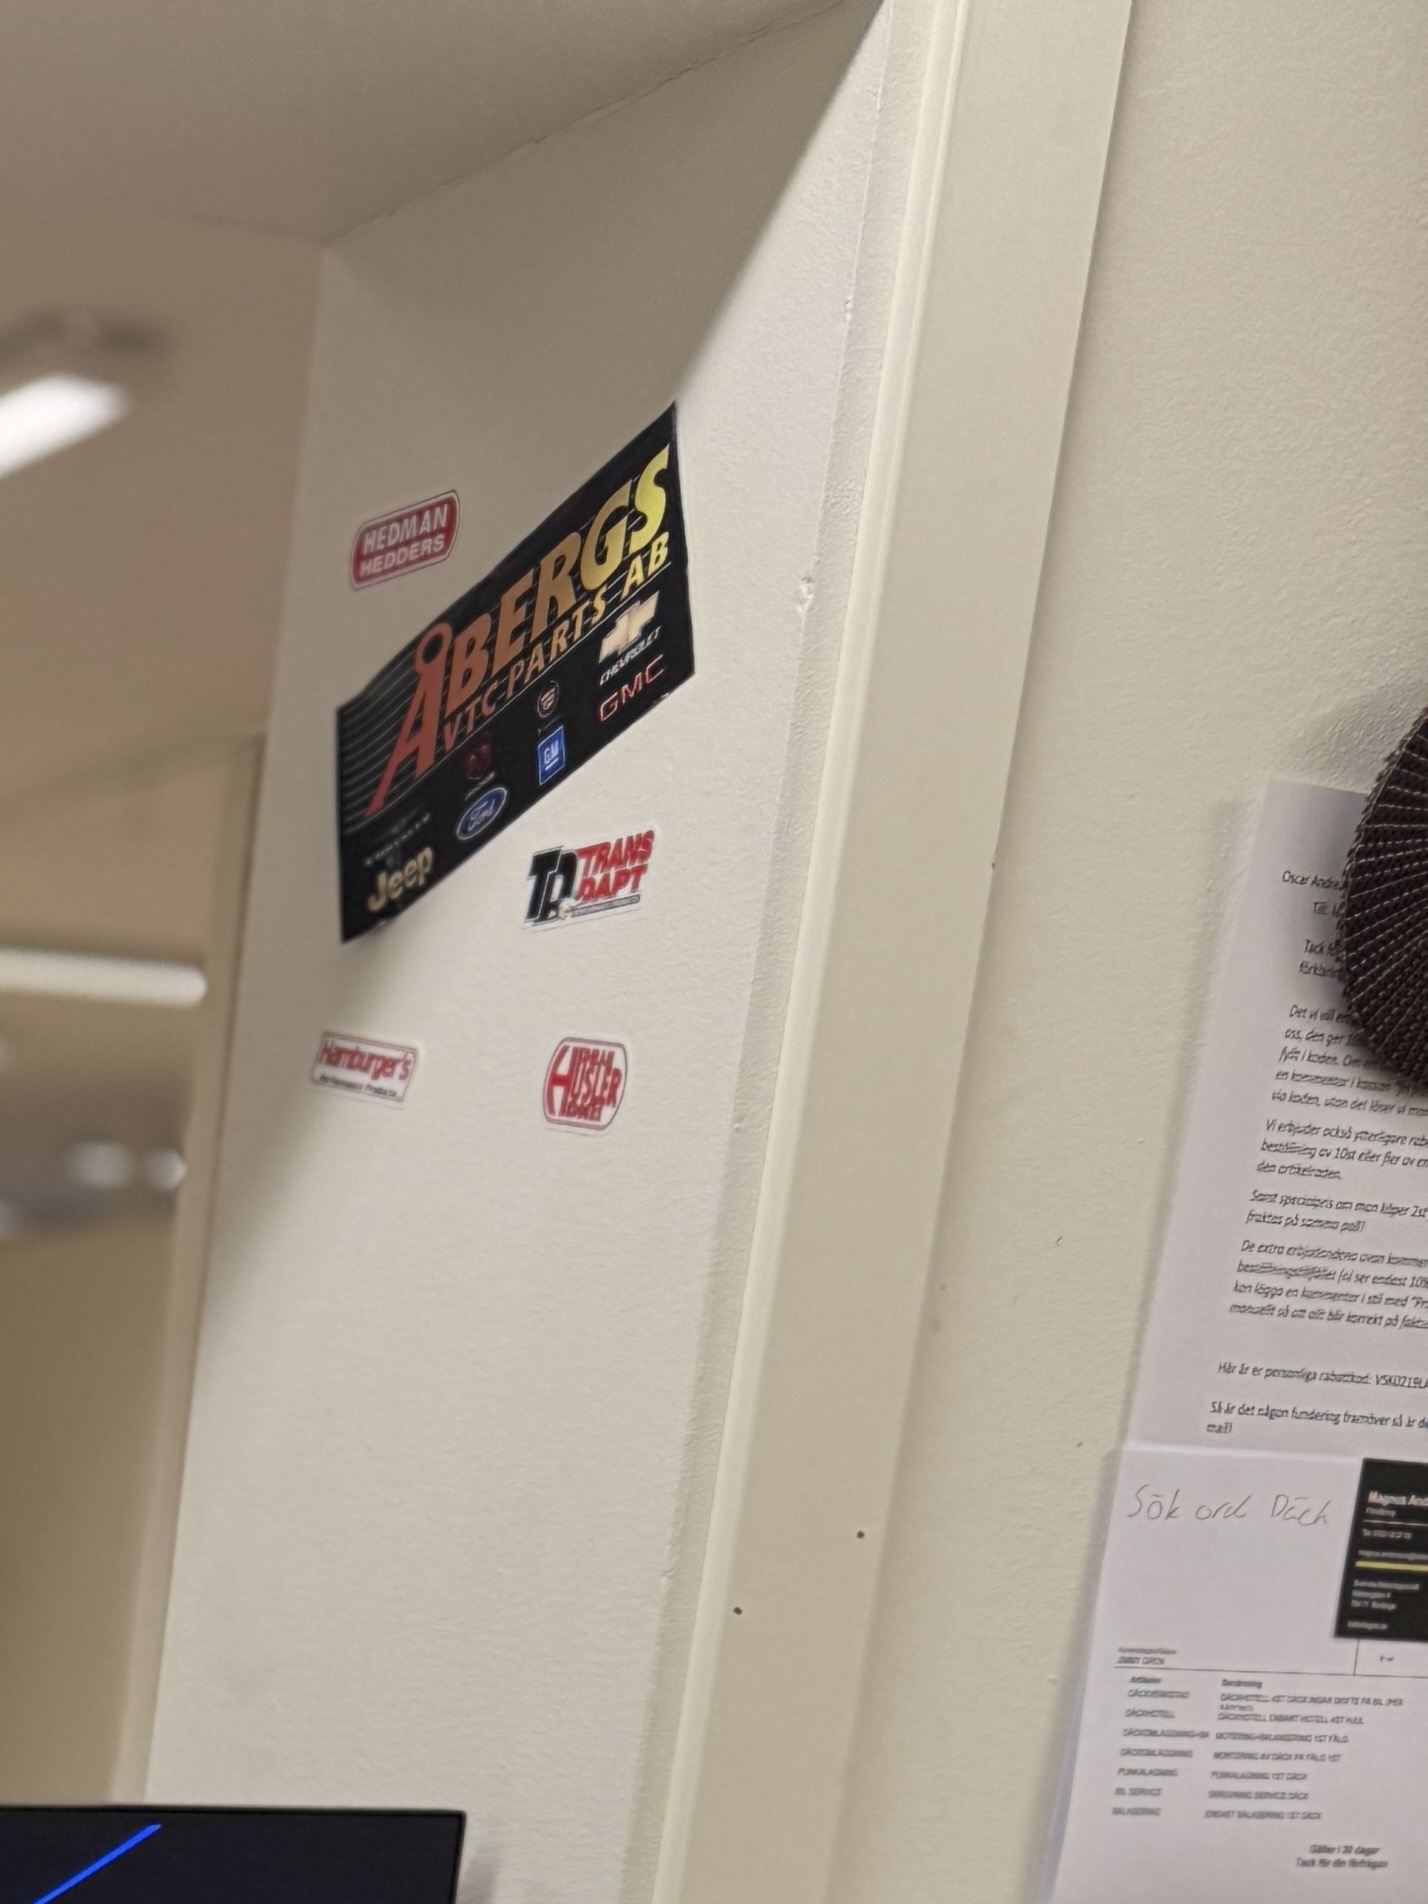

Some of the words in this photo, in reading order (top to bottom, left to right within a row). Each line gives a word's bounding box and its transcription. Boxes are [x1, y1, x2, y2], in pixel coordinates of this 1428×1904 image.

[363, 504, 448, 555] HEDMAN
[360, 534, 445, 578] HEDDERS
[365, 443, 670, 817] ÅBERGS
[506, 583, 607, 700] PARTS
[621, 531, 670, 601] AB
[599, 626, 662, 687] CHEVROLET
[599, 654, 666, 722] GMC
[543, 739, 561, 764] GM
[465, 800, 496, 832] Ford
[576, 829, 655, 878] TRANS
[366, 846, 434, 915] Jeep
[317, 1037, 413, 1081] Hamburger's
[1218, 1362, 1237, 1375] Här
[1127, 1484, 1180, 1521] Sök
[1195, 1494, 1252, 1520] ord
